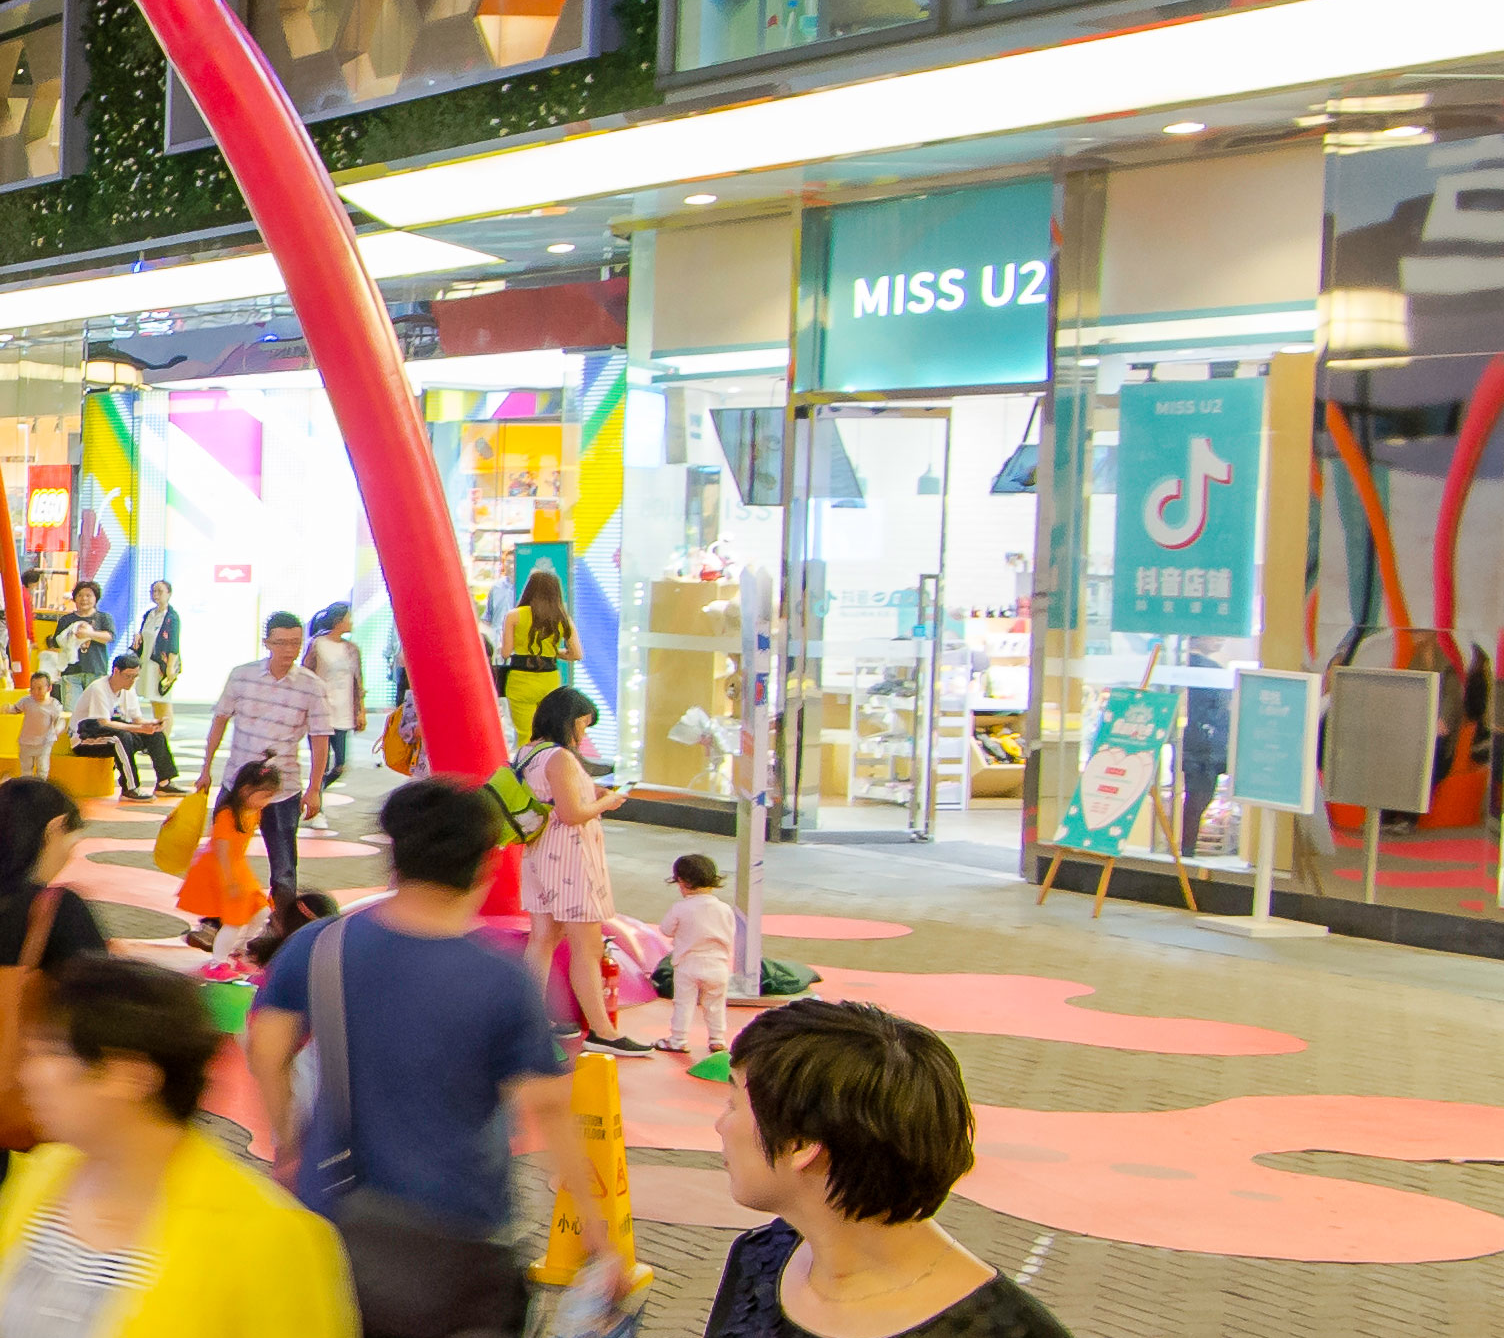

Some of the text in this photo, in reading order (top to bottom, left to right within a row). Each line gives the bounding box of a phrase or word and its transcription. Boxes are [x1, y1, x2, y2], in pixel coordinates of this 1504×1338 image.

[853, 259, 1050, 320] MISS U2
[1155, 398, 1224, 416] MISS U2
